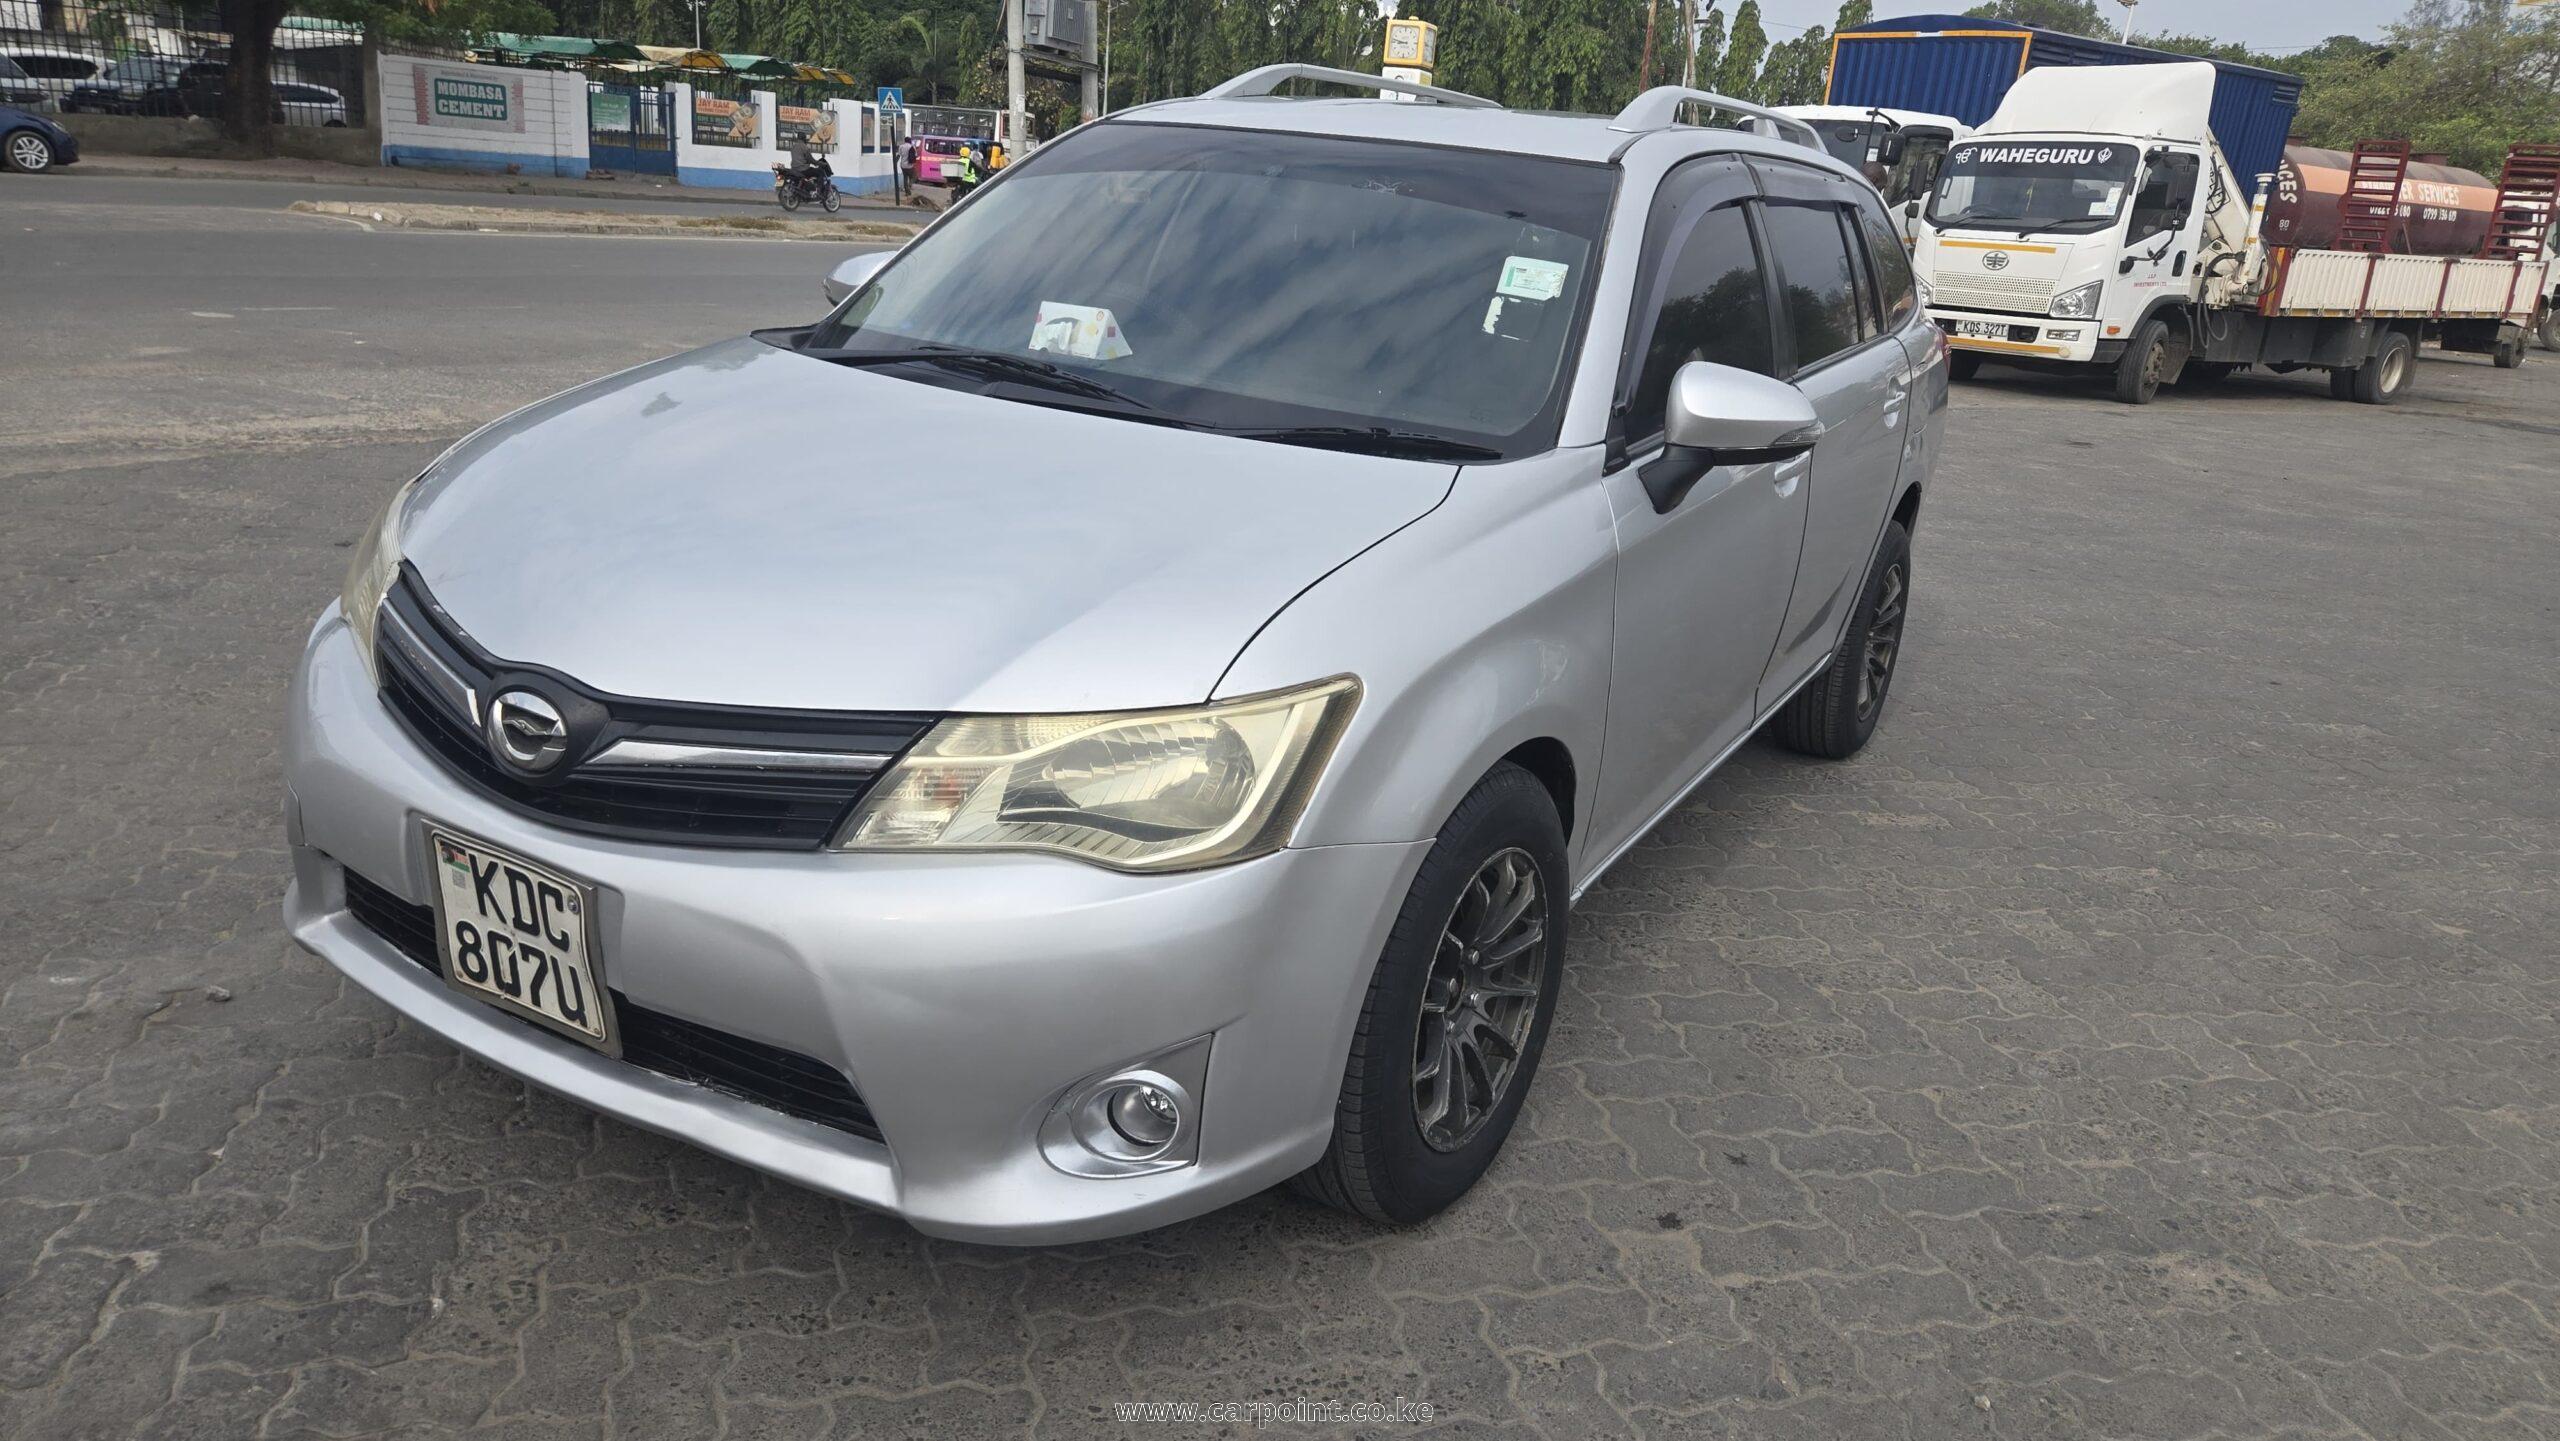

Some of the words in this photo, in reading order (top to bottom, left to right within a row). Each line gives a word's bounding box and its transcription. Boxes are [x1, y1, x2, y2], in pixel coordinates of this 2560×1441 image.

[437, 81, 504, 100] MOMBASA
[438, 99, 505, 118] CEMENT
[713, 100, 730, 109] RAM
[794, 108, 811, 117] RAM
[1979, 147, 2095, 165] WAHEGURU
[2417, 182, 2460, 206] SERVICES
[2279, 219, 2290, 228] 80
[1963, 321, 1981, 333] KDS
[1983, 323, 2006, 335] 327T
[468, 853, 570, 952] KDC
[455, 920, 588, 1028] 807U
